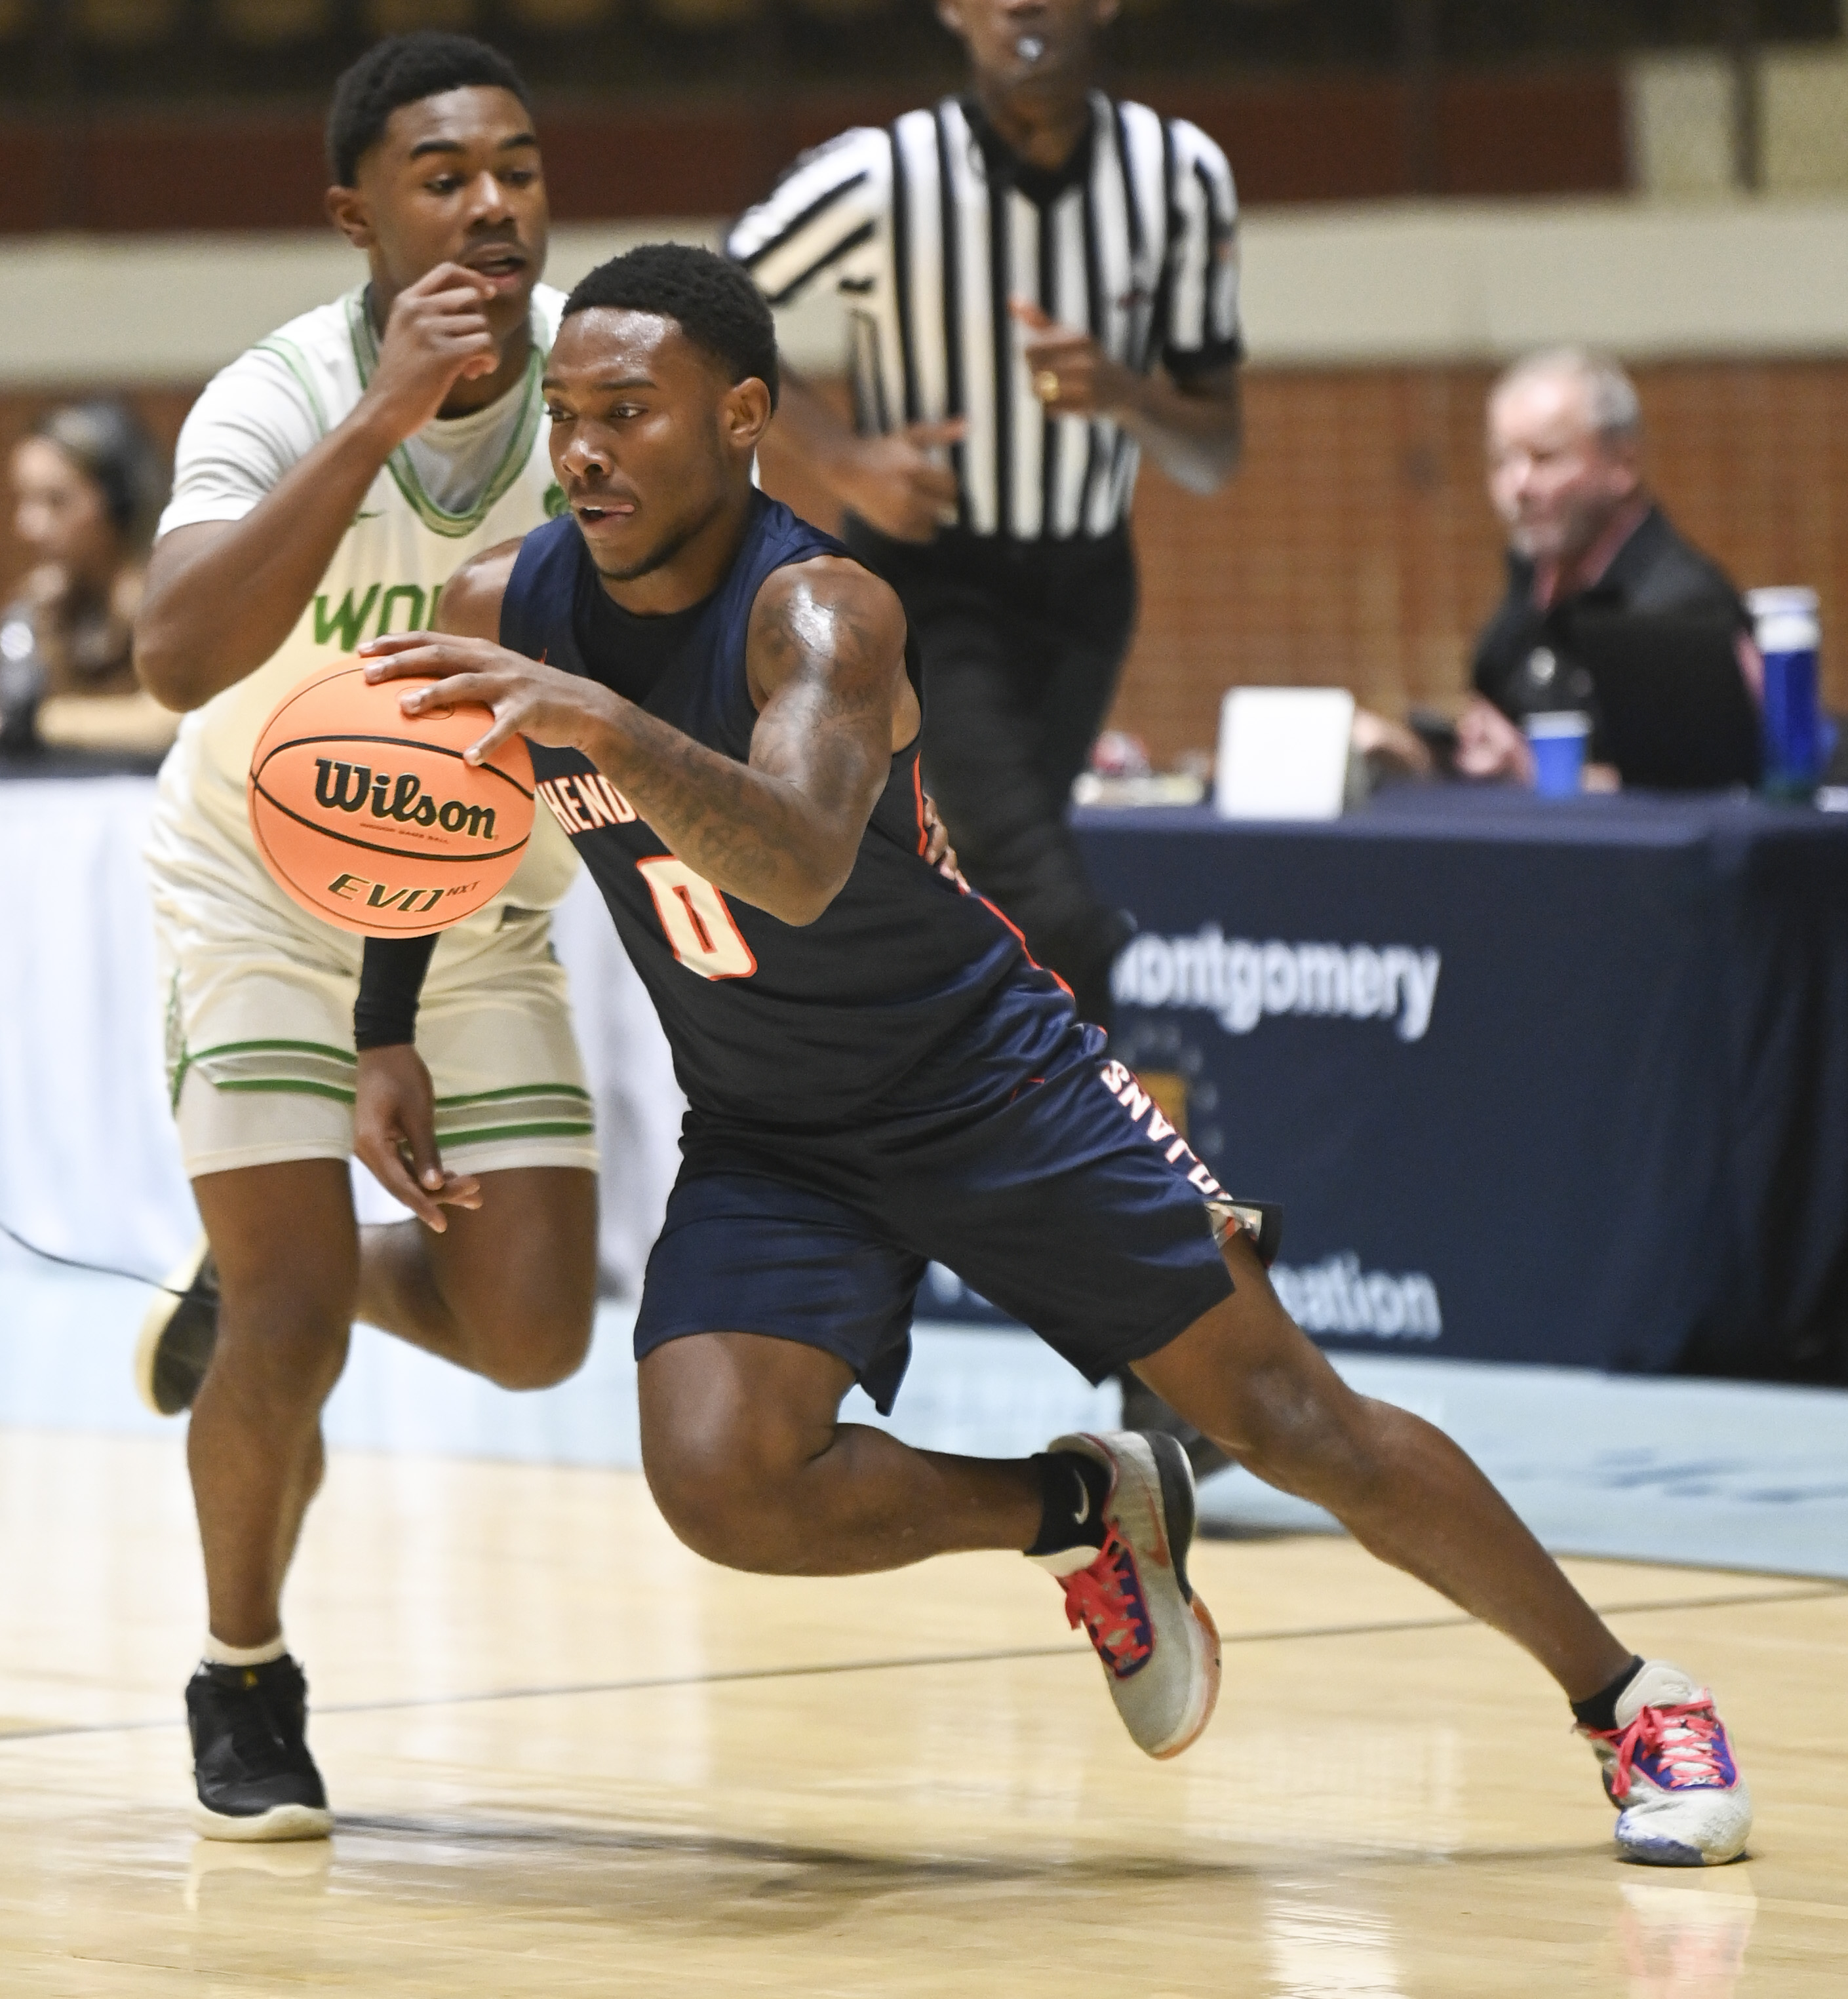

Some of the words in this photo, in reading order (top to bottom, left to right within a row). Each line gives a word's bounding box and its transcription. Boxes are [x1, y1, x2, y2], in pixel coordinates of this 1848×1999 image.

[314, 756, 496, 840] Wilson
[328, 873, 446, 913] EVO
[445, 880, 481, 897] NXT
[636, 854, 758, 982] 0
